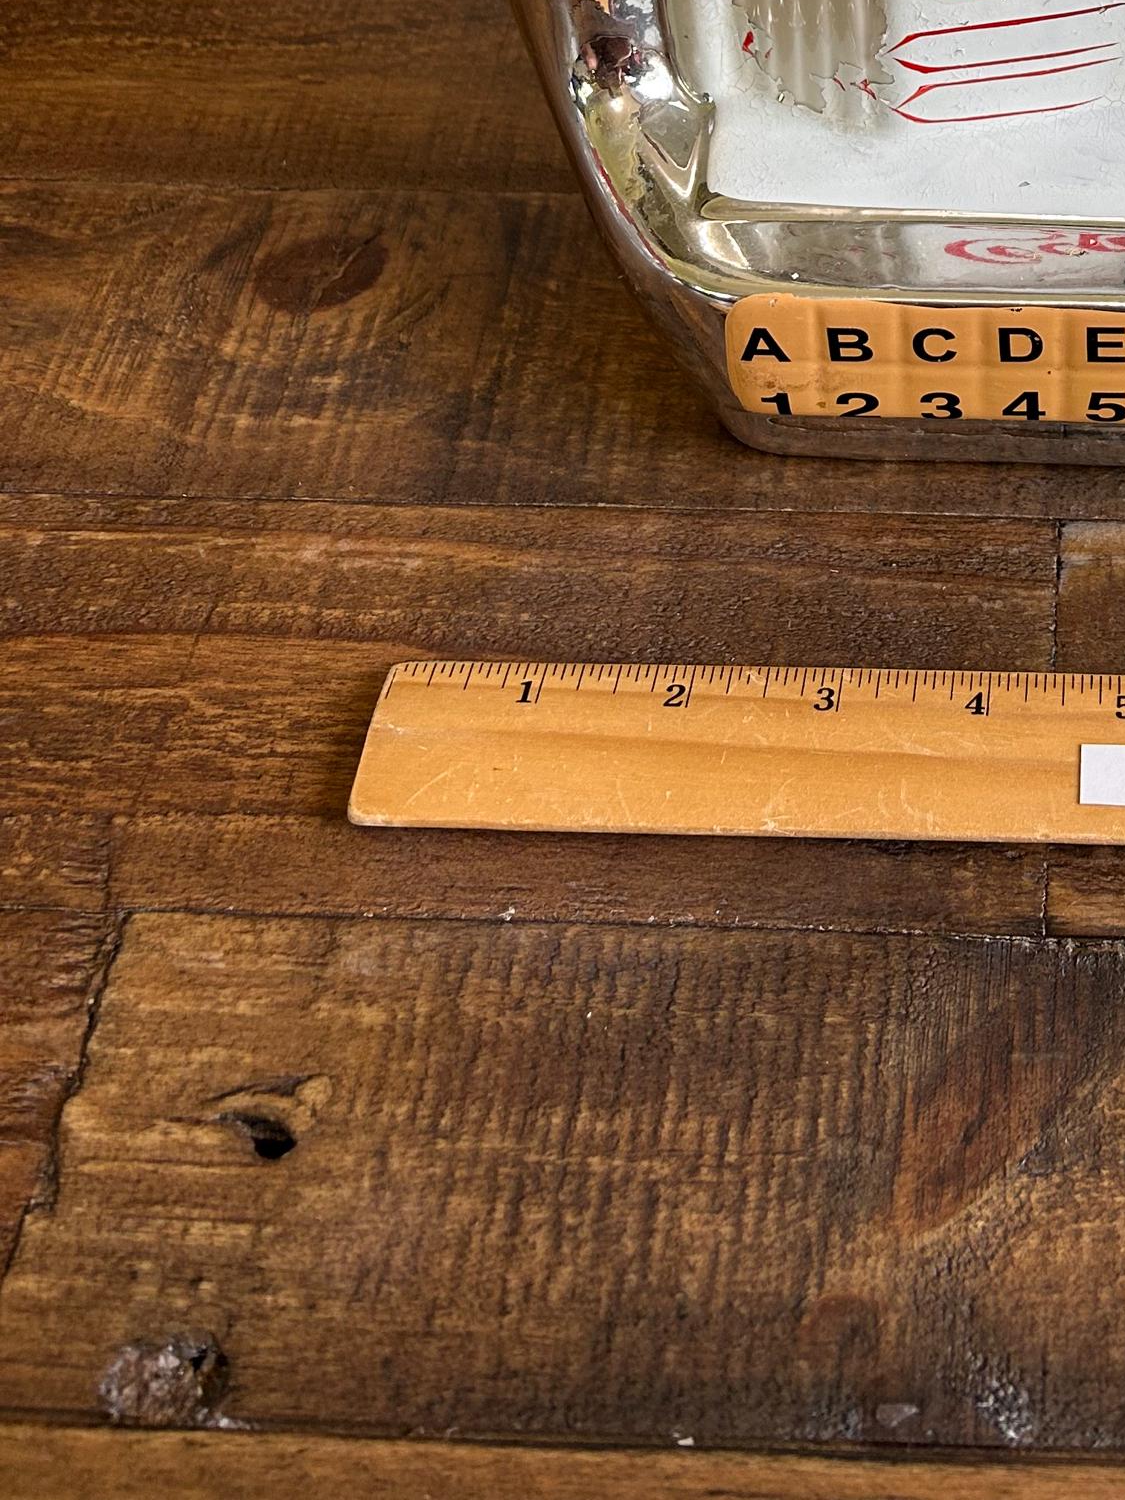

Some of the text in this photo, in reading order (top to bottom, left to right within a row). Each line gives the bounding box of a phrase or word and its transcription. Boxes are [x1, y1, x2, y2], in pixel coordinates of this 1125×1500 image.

[740, 327, 792, 362] A
[826, 327, 874, 362] B
[912, 328, 958, 362] C
[998, 327, 1044, 362] D
[760, 392, 793, 415] 1
[835, 392, 881, 417] 2
[919, 392, 963, 419] 3
[1002, 392, 1046, 420] 4
[515, 681, 533, 703] 1
[663, 684, 686, 707] 2
[813, 687, 835, 711] 3
[964, 691, 985, 715] 4
